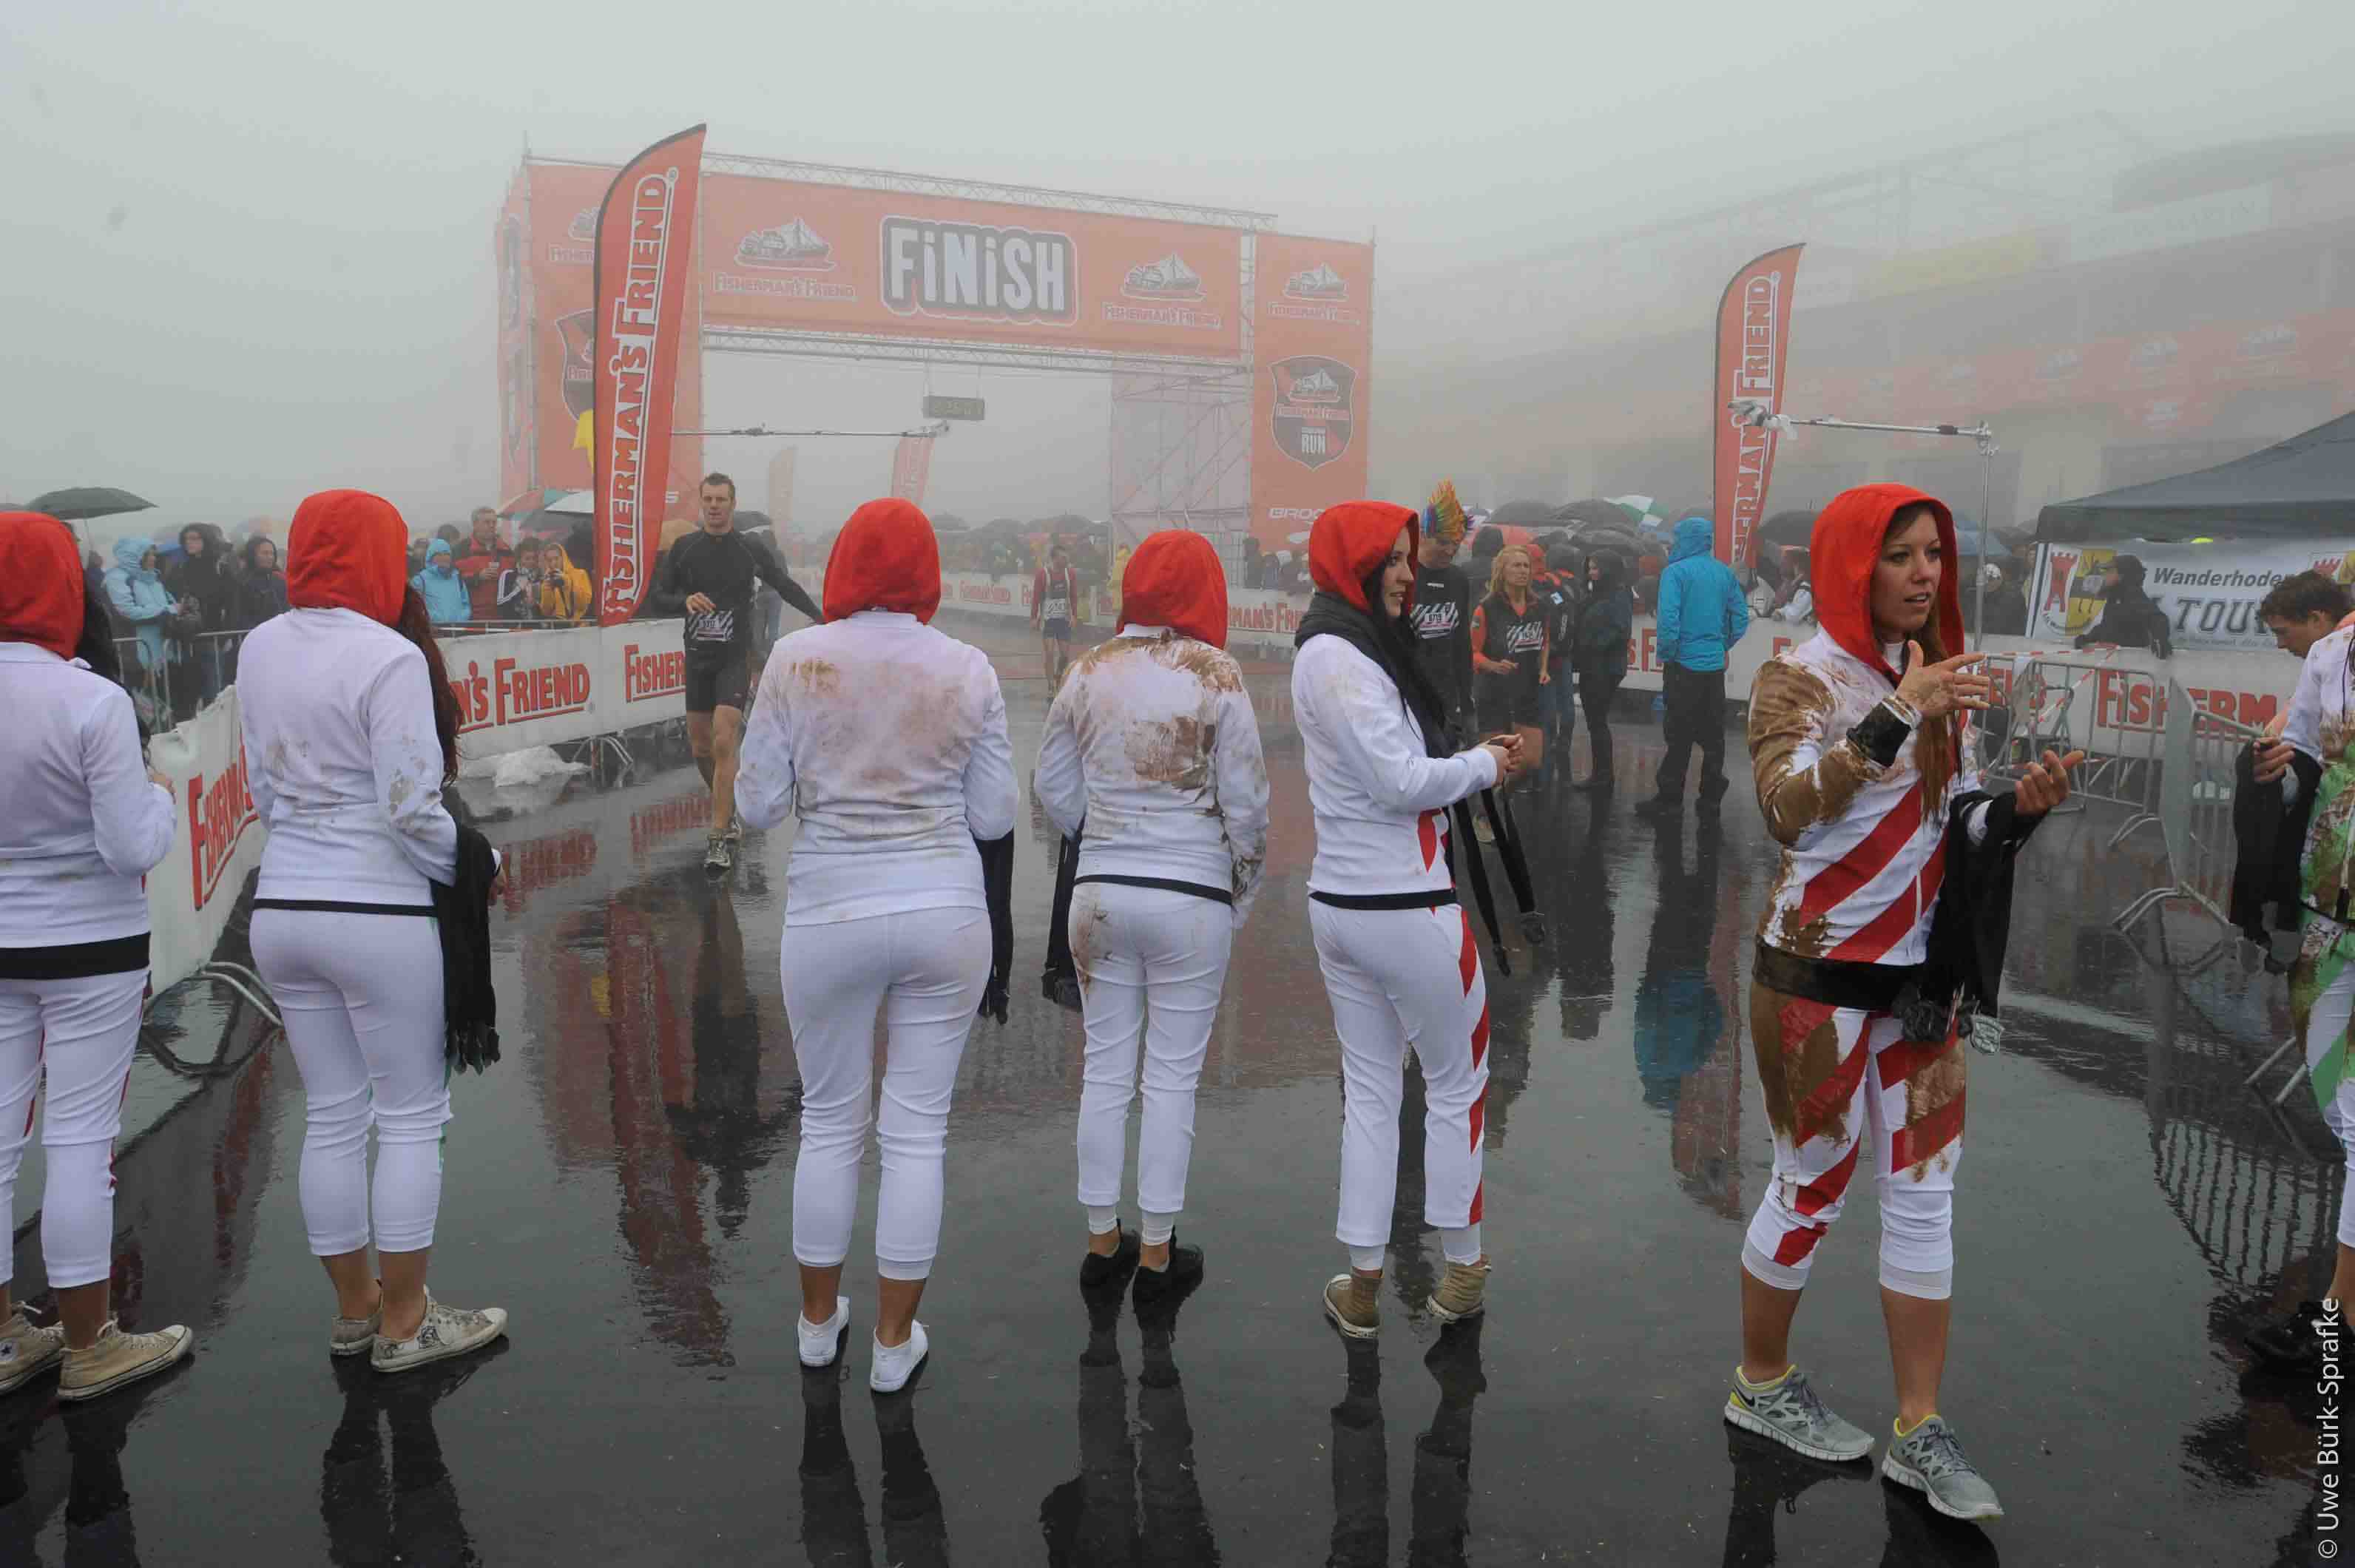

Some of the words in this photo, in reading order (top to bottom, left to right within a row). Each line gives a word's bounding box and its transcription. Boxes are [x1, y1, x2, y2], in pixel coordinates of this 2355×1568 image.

[613, 175, 668, 337] FRIEND
[1734, 276, 1774, 397] FRIEND
[1301, 433, 1326, 454] RUN
[494, 657, 591, 726] FRIEND
